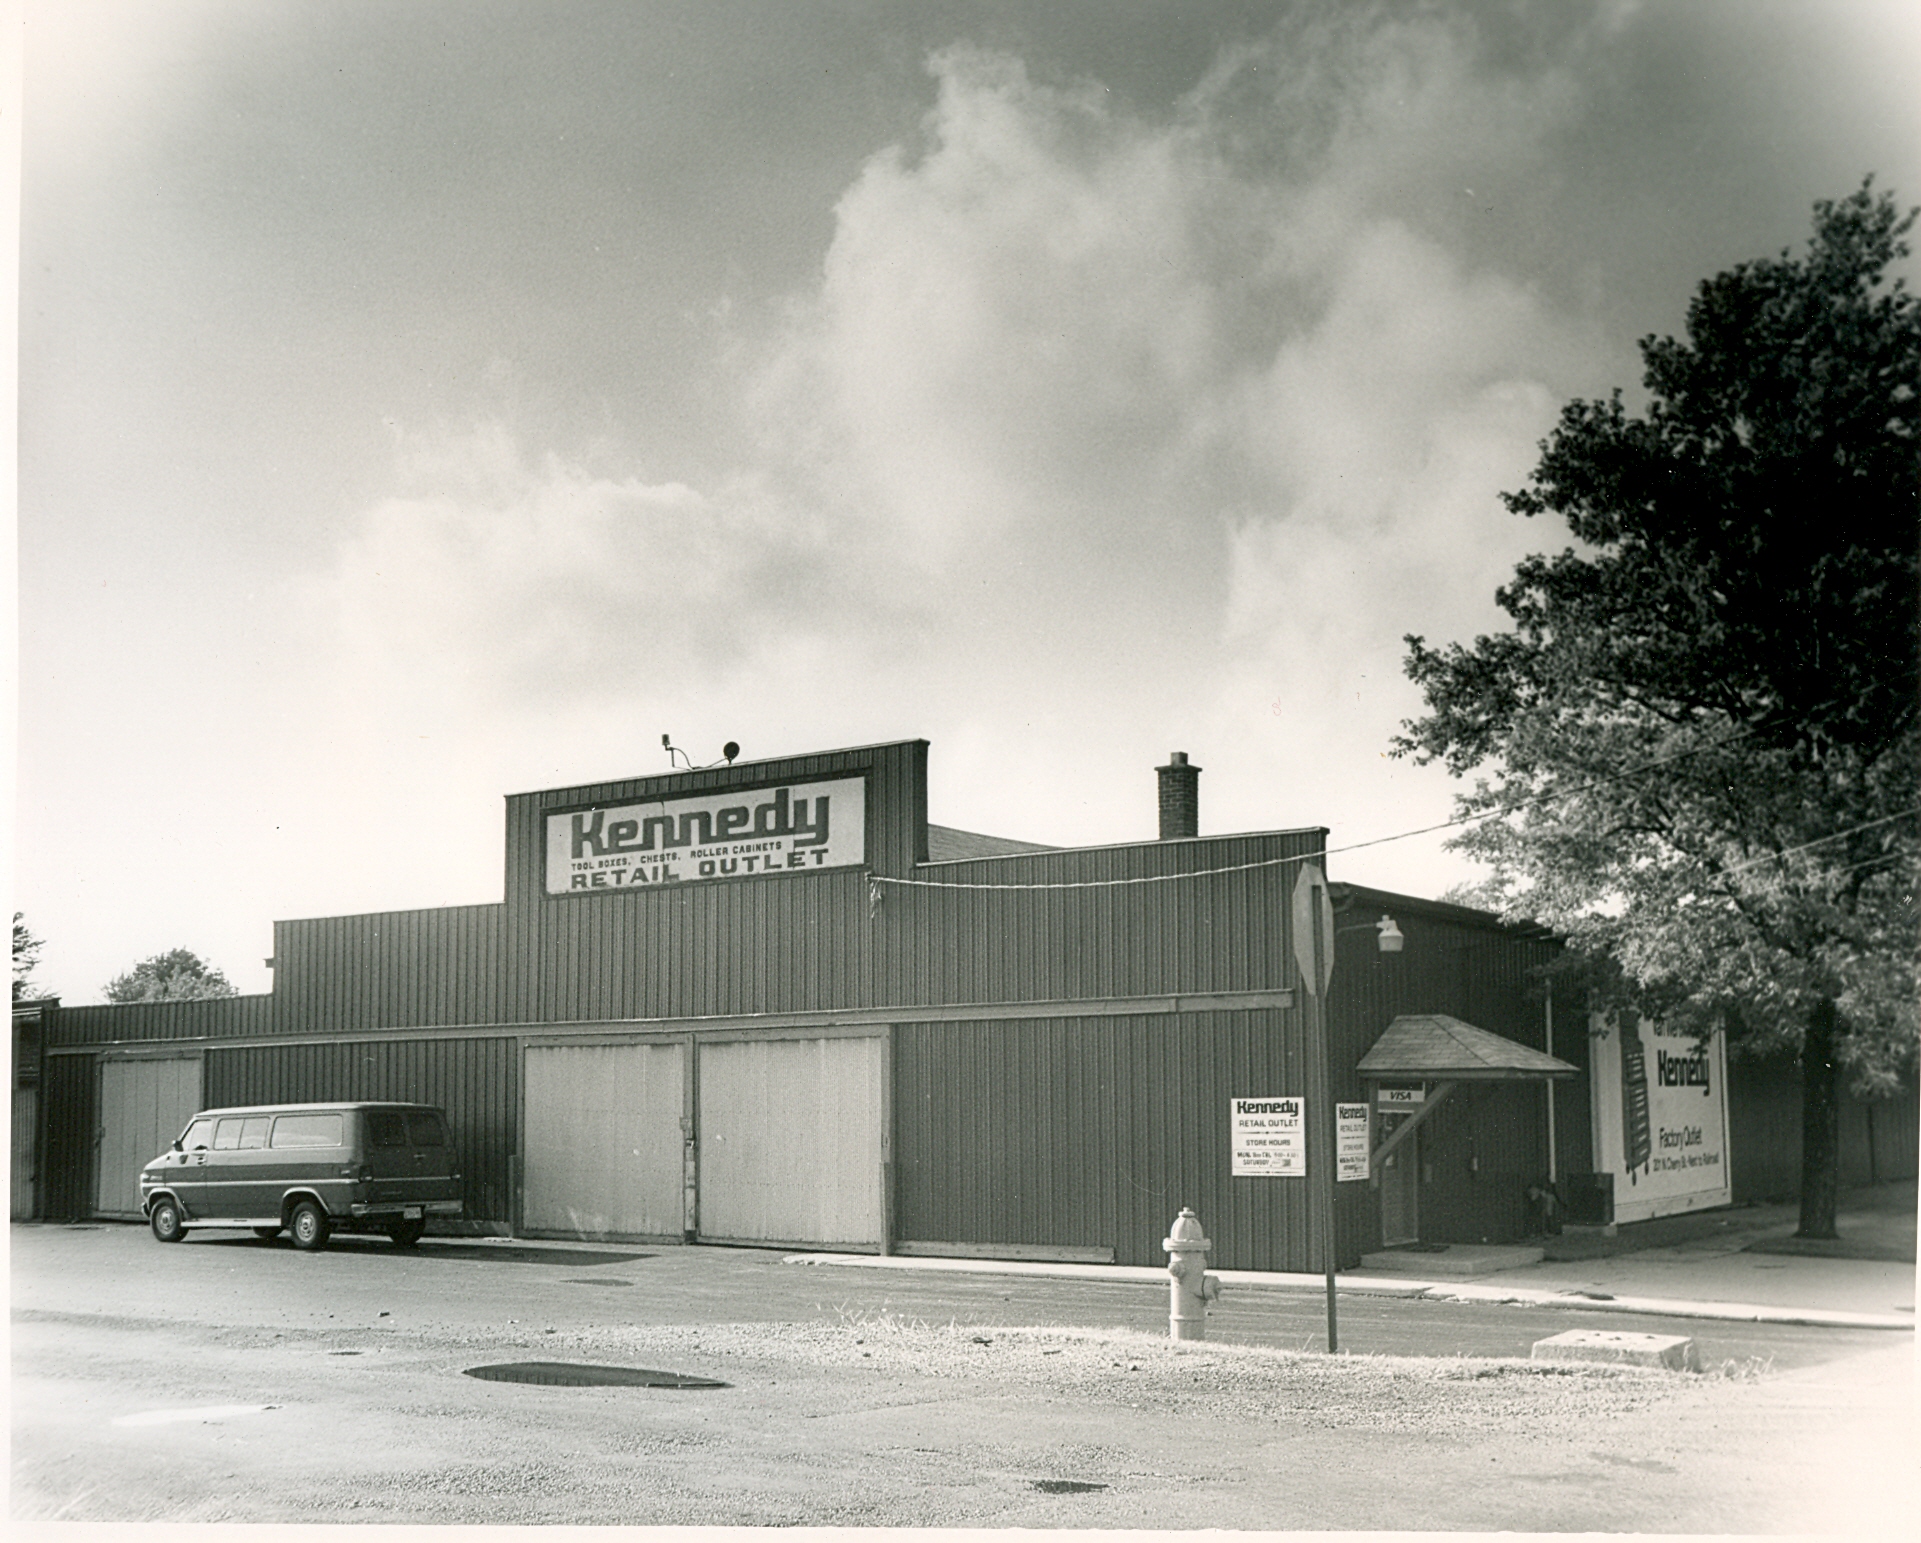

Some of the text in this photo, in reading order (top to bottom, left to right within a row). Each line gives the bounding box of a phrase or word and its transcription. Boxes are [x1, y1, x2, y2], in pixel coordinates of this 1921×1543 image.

[571, 787, 830, 860] Kennedy
[571, 841, 782, 871] TOOL BOXES, CHESTS, ROLLER CABINETS
[571, 848, 829, 889] RETAIL OUTLET
[1657, 1049, 1710, 1096] Kennedy
[1237, 1100, 1298, 1117] Kennedy
[1390, 1091, 1411, 1100] VISA
[1239, 1119, 1298, 1128] RETAIL OUTLET
[1339, 1106, 1367, 1122] Kennedy
[1659, 1125, 1702, 1152] Factory Outlet
